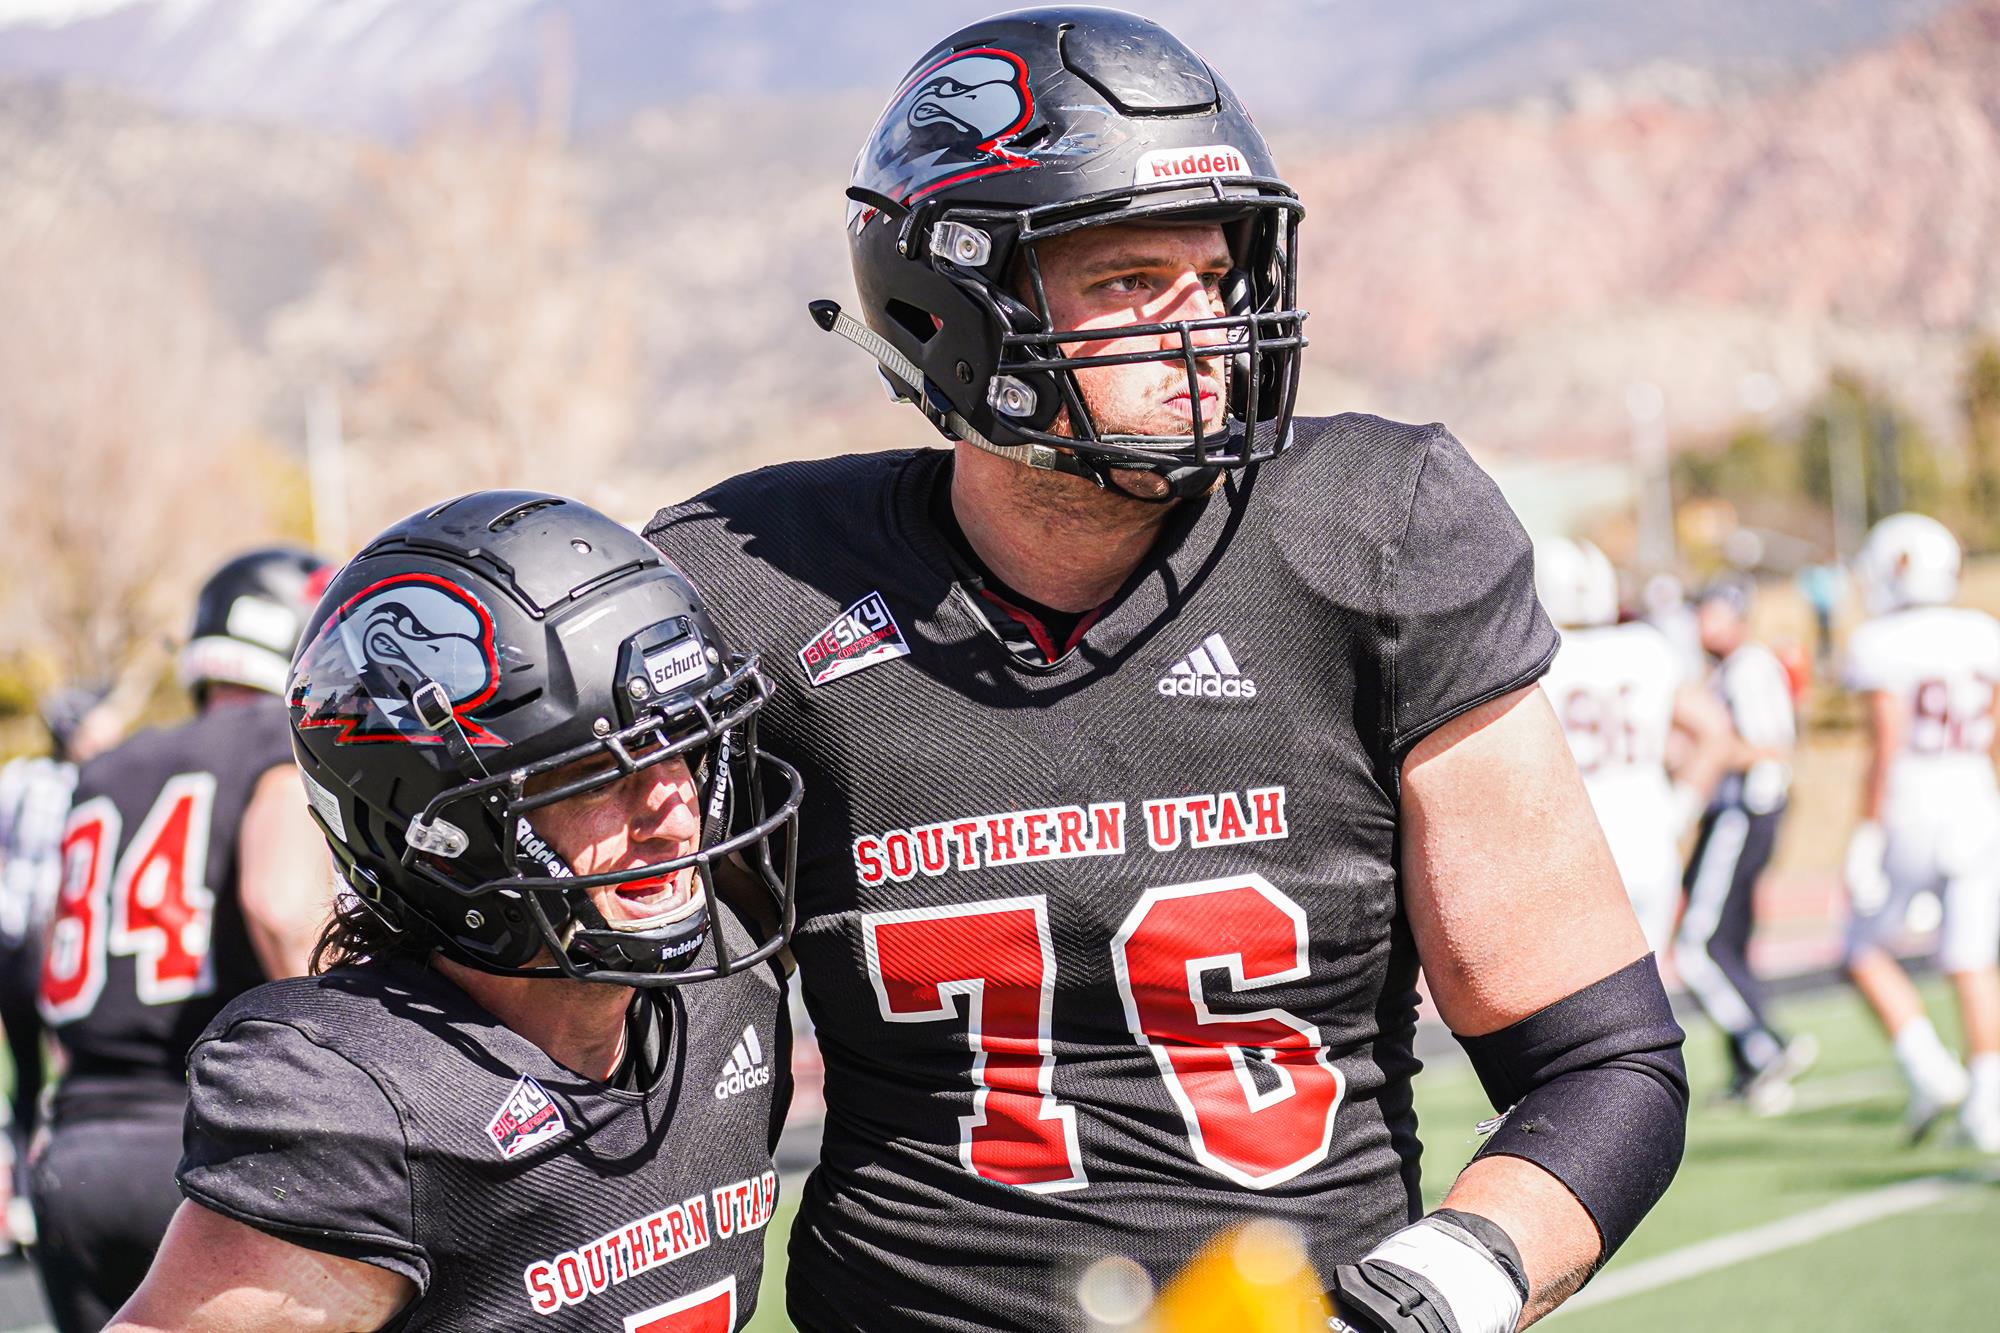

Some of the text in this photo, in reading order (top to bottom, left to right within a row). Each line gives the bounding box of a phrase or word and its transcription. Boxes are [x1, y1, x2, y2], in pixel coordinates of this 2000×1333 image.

[803, 598, 889, 667] BIG SKY
[655, 651, 702, 684] schutt
[1158, 673, 1257, 698] adidas
[853, 786, 1289, 887] SOUTHERN UTAH
[36, 771, 217, 1026] 84
[662, 933, 704, 960] Riddell
[861, 873, 1346, 1194] 76
[491, 1109, 519, 1141] BIG
[509, 1079, 550, 1126] SKY
[714, 1065, 769, 1100] adidas
[524, 1195, 710, 1316] SOUTHERN
[712, 1170, 776, 1240] UTAH
